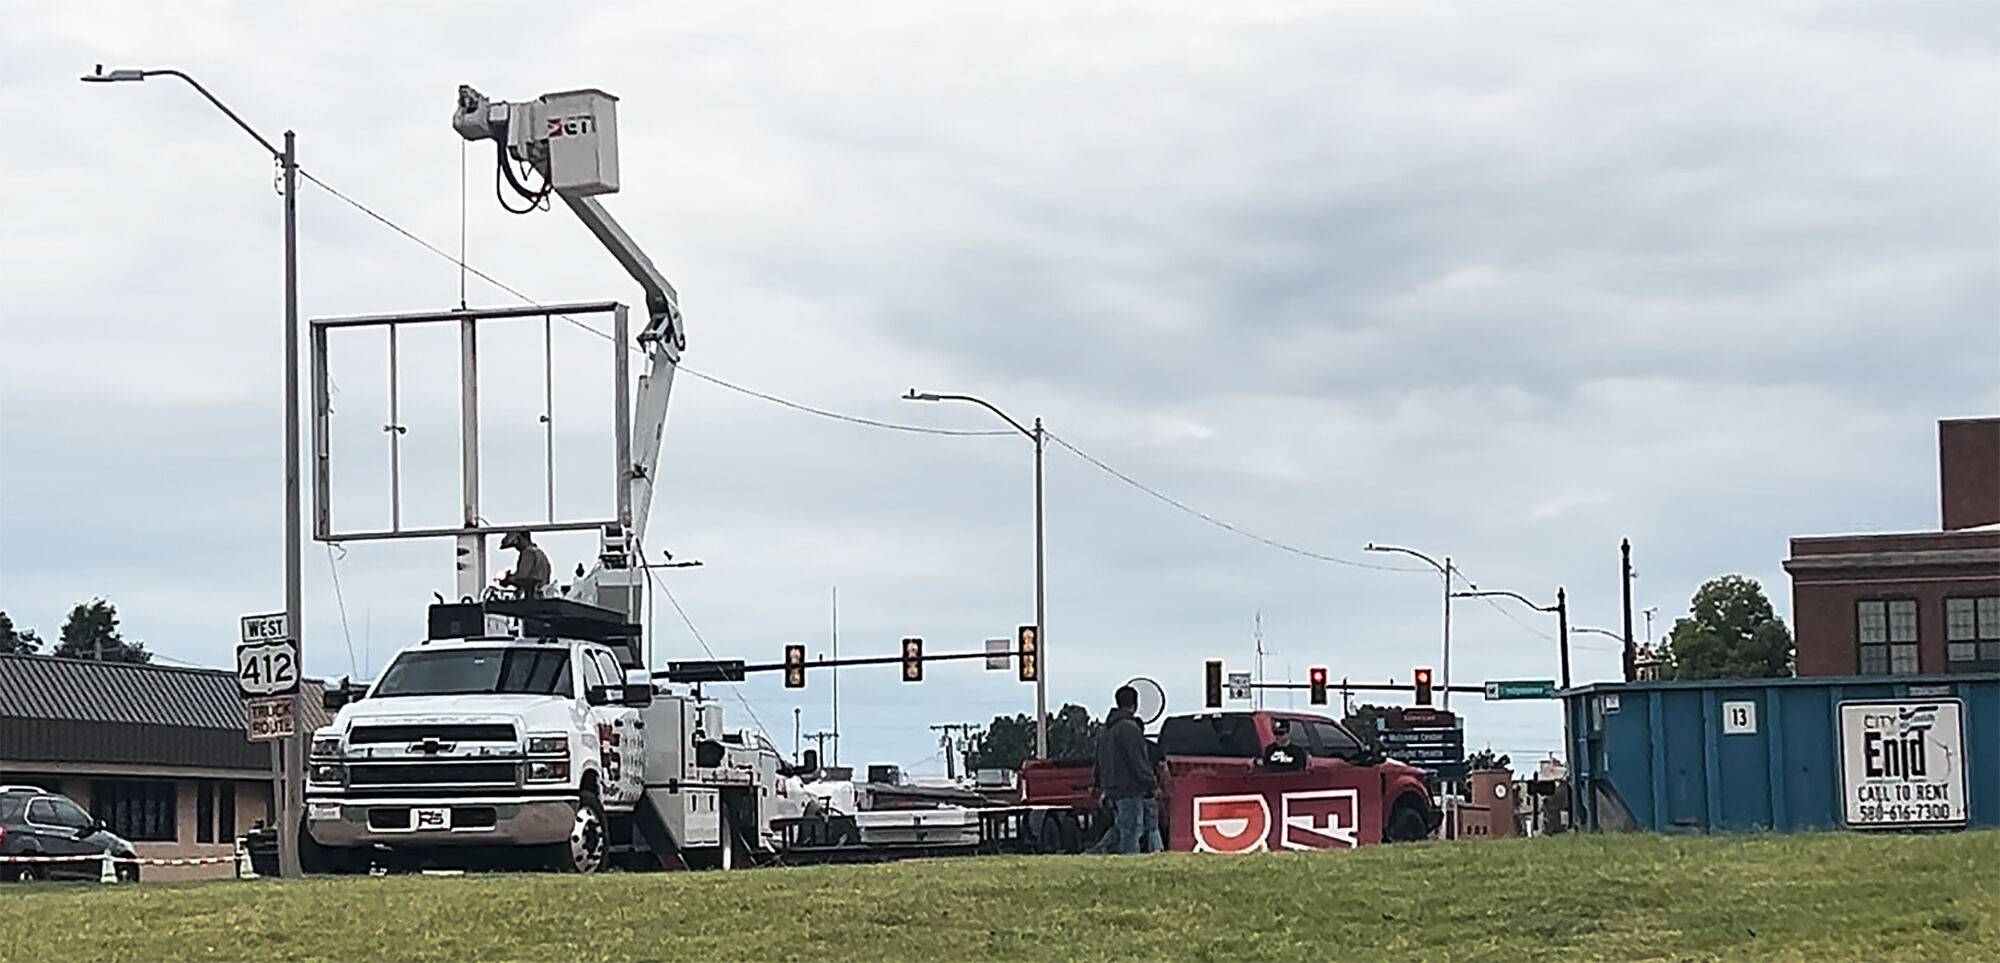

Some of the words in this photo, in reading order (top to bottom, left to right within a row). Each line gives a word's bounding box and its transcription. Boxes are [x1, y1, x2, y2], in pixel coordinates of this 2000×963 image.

[246, 620, 283, 638] WEST
[241, 652, 293, 685] 412
[252, 703, 292, 719] TRUCK
[1732, 708, 1747, 726] 13
[252, 719, 292, 735] ROUTE
[1864, 715, 1896, 729] CITY
[1864, 729, 1926, 782] Enid
[1858, 785, 1890, 802] CALL
[1895, 785, 1911, 801] TO
[1916, 783, 1948, 801] RENT
